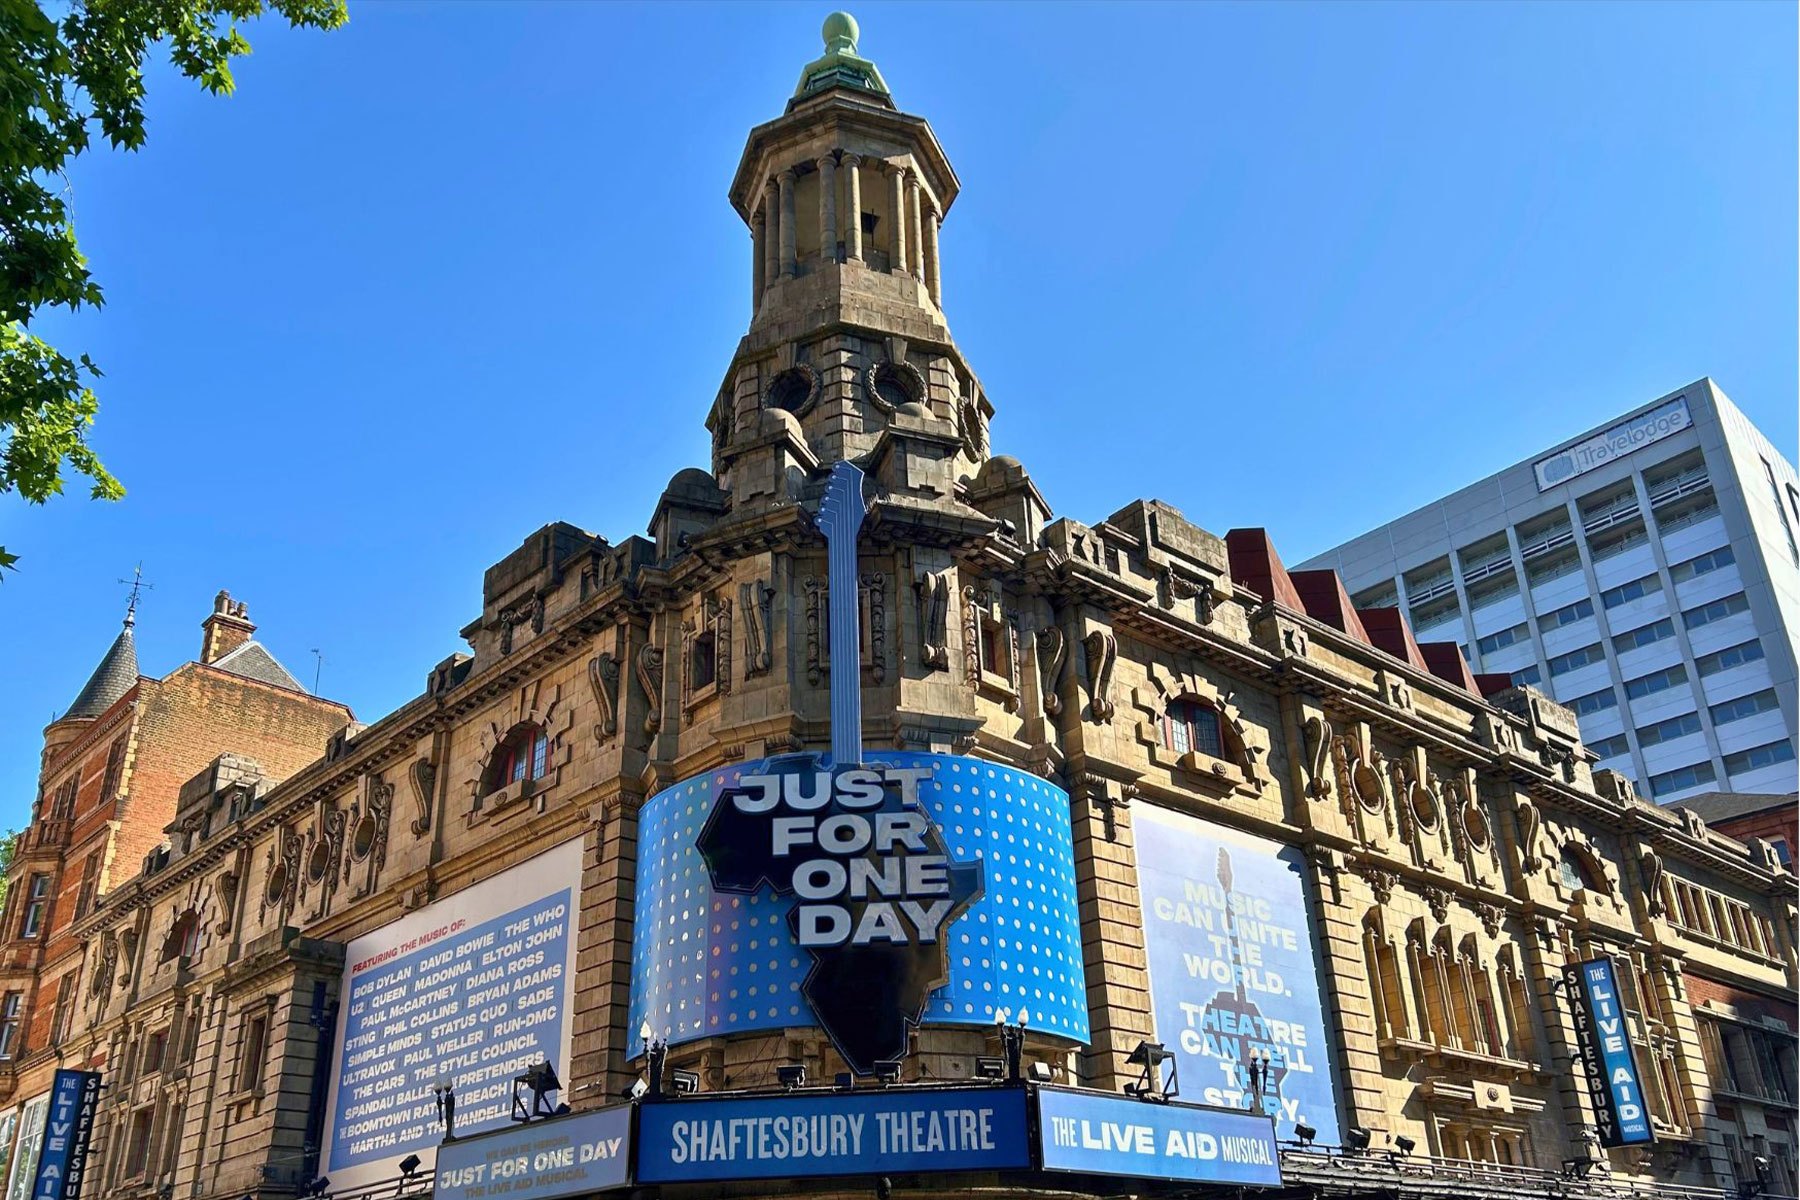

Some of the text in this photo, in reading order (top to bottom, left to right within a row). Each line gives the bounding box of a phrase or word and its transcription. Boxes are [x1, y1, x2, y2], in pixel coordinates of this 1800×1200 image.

[1577, 412, 1682, 466] Travelodge
[732, 768, 932, 813] JUST
[772, 812, 931, 857] FOR
[792, 854, 950, 900] ONE
[1184, 879, 1272, 922] MUSIC
[352, 919, 466, 974] FEATURING THE MUSIC OF:
[799, 900, 955, 947] DAY
[1153, 896, 1298, 952] CAN UNITE
[1208, 934, 1263, 967] THE
[351, 923, 563, 1016] U2 QUEEN MADONNA ELTON JOHN
[353, 904, 565, 999] BOB DYLAN DAVID BOWIE THE WHO
[1183, 953, 1292, 998] WORLD.
[1589, 967, 1606, 981] THE
[345, 963, 562, 1052] STING PHIL COLLINS BRYAN ADAMS
[360, 950, 545, 1030] PAUL McCARTNEY DIANA ROSS
[342, 1005, 557, 1087] ULTRAVOX PAUL WELLER RUN-DMC
[347, 985, 555, 1068] SIMPLE MINDS STATUS QUO SADE
[1180, 1002, 1308, 1047] THEATRE
[1180, 1029, 1241, 1062] CAN
[352, 1032, 538, 1100] THE CARS THE STYLE COUNCIL
[1567, 971, 1613, 1140] SHAFTESBURY
[1593, 985, 1640, 1121] LIVE AID
[62, 1077, 76, 1089] THE
[344, 1095, 394, 1120] SPANDAU
[458, 1050, 545, 1087] PRETENDERS
[347, 1108, 411, 1138] BOOMTOWN
[464, 1081, 508, 1106] BEACH
[48, 1092, 73, 1151] LIVE
[350, 1132, 397, 1155] MARTHA
[398, 1125, 424, 1142] AND
[671, 1109, 995, 1164] SHAFTESBURY THEATRE
[1052, 1116, 1274, 1166] THE LIVE AID MUSICAL
[440, 1137, 622, 1190] JUST FOR ONE DAY
